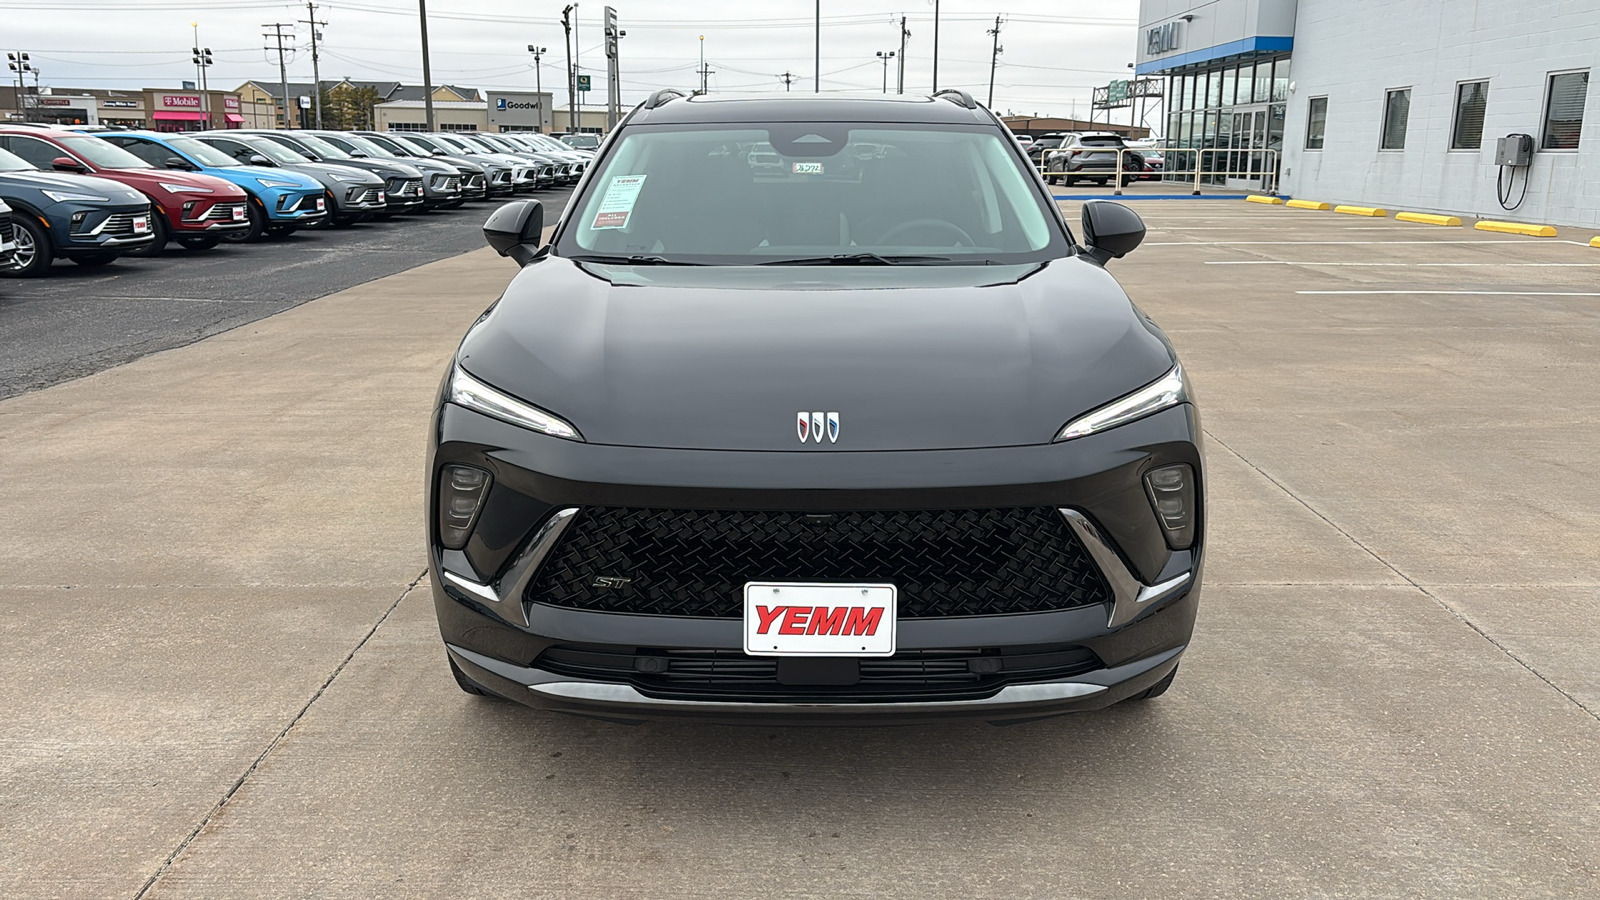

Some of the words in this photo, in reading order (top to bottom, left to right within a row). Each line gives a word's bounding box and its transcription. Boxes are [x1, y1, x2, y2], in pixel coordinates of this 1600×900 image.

[173, 97, 198, 106] Mobile
[592, 576, 631, 589] ST
[755, 605, 885, 636] YEMM
